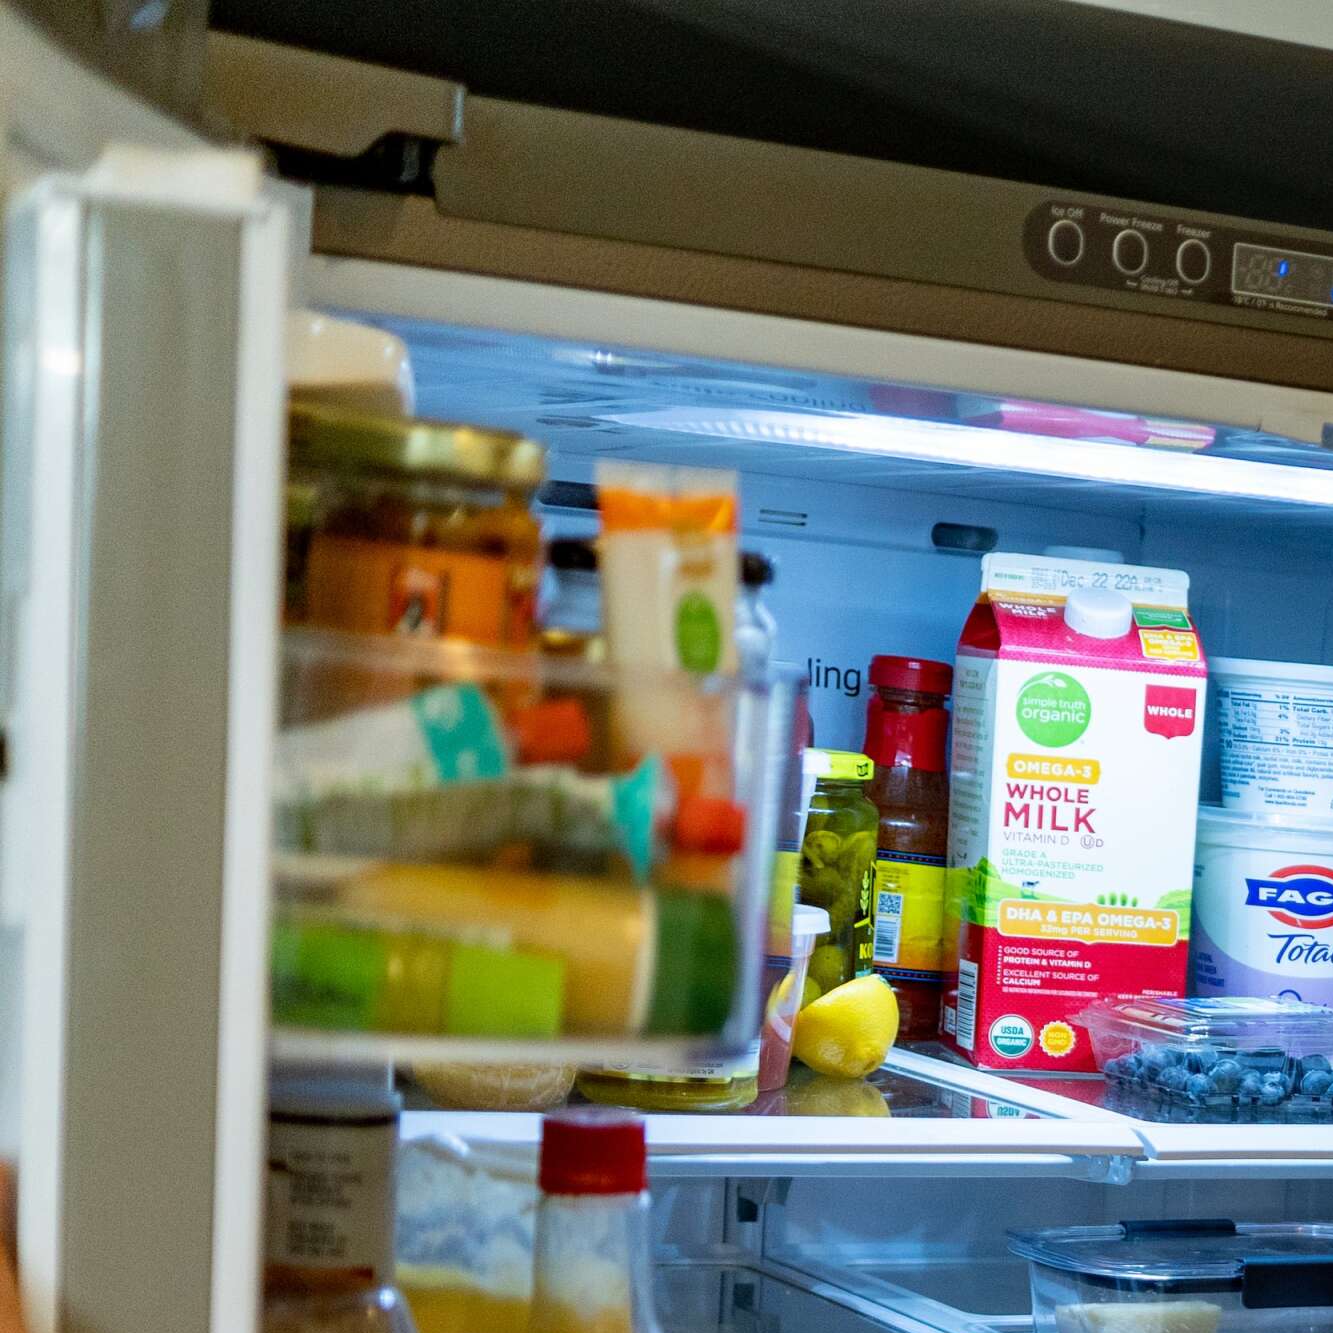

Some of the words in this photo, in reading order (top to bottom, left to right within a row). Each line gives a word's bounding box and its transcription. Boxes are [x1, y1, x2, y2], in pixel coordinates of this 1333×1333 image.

[1051, 207, 1066, 217] Ice
[1067, 208, 1084, 219] Off
[1100, 212, 1130, 226] Power
[1131, 217, 1163, 232] Freeze
[1176, 224, 1212, 239] Freezer
[999, 602, 1056, 613] WHOLE
[1011, 608, 1047, 617] MILK
[1023, 697, 1057, 708] simple
[1059, 699, 1086, 710] truth
[1021, 707, 1085, 724] organic
[1147, 705, 1193, 719] WHOLE
[1014, 760, 1092, 778] OMEGA-3
[1006, 782, 1089, 804] WHOLE
[1003, 801, 1096, 834] MILK
[1003, 831, 1056, 844] VITAMIN
[1061, 835, 1070, 845] D
[1002, 848, 1037, 858] GRADE
[1039, 850, 1047, 859] A
[1002, 857, 1104, 872] ULTRA-PASTEURIZED
[1002, 867, 1075, 879] HOMOGENIZED
[1006, 907, 1042, 921] DHA
[1046, 909, 1058, 922] &
[1061, 911, 1093, 925] EPA
[1098, 913, 1172, 930] OMEGA-3
[1071, 926, 1090, 936] PER
[1093, 927, 1138, 938] SERVING
[1003, 946, 1030, 955] GOOD
[1032, 948, 1065, 958] SOURCE
[1067, 950, 1079, 958] OF
[1003, 956, 1040, 966] PROTEIN
[1041, 958, 1048, 966] &
[1049, 959, 1084, 968] VITAMIN
[1003, 969, 1050, 978] EXCELLENT
[1052, 971, 1085, 981] SOURCE
[1002, 977, 1041, 986] CALCIUM
[1001, 1025, 1024, 1035] USDA
[1048, 1031, 1067, 1039] NON
